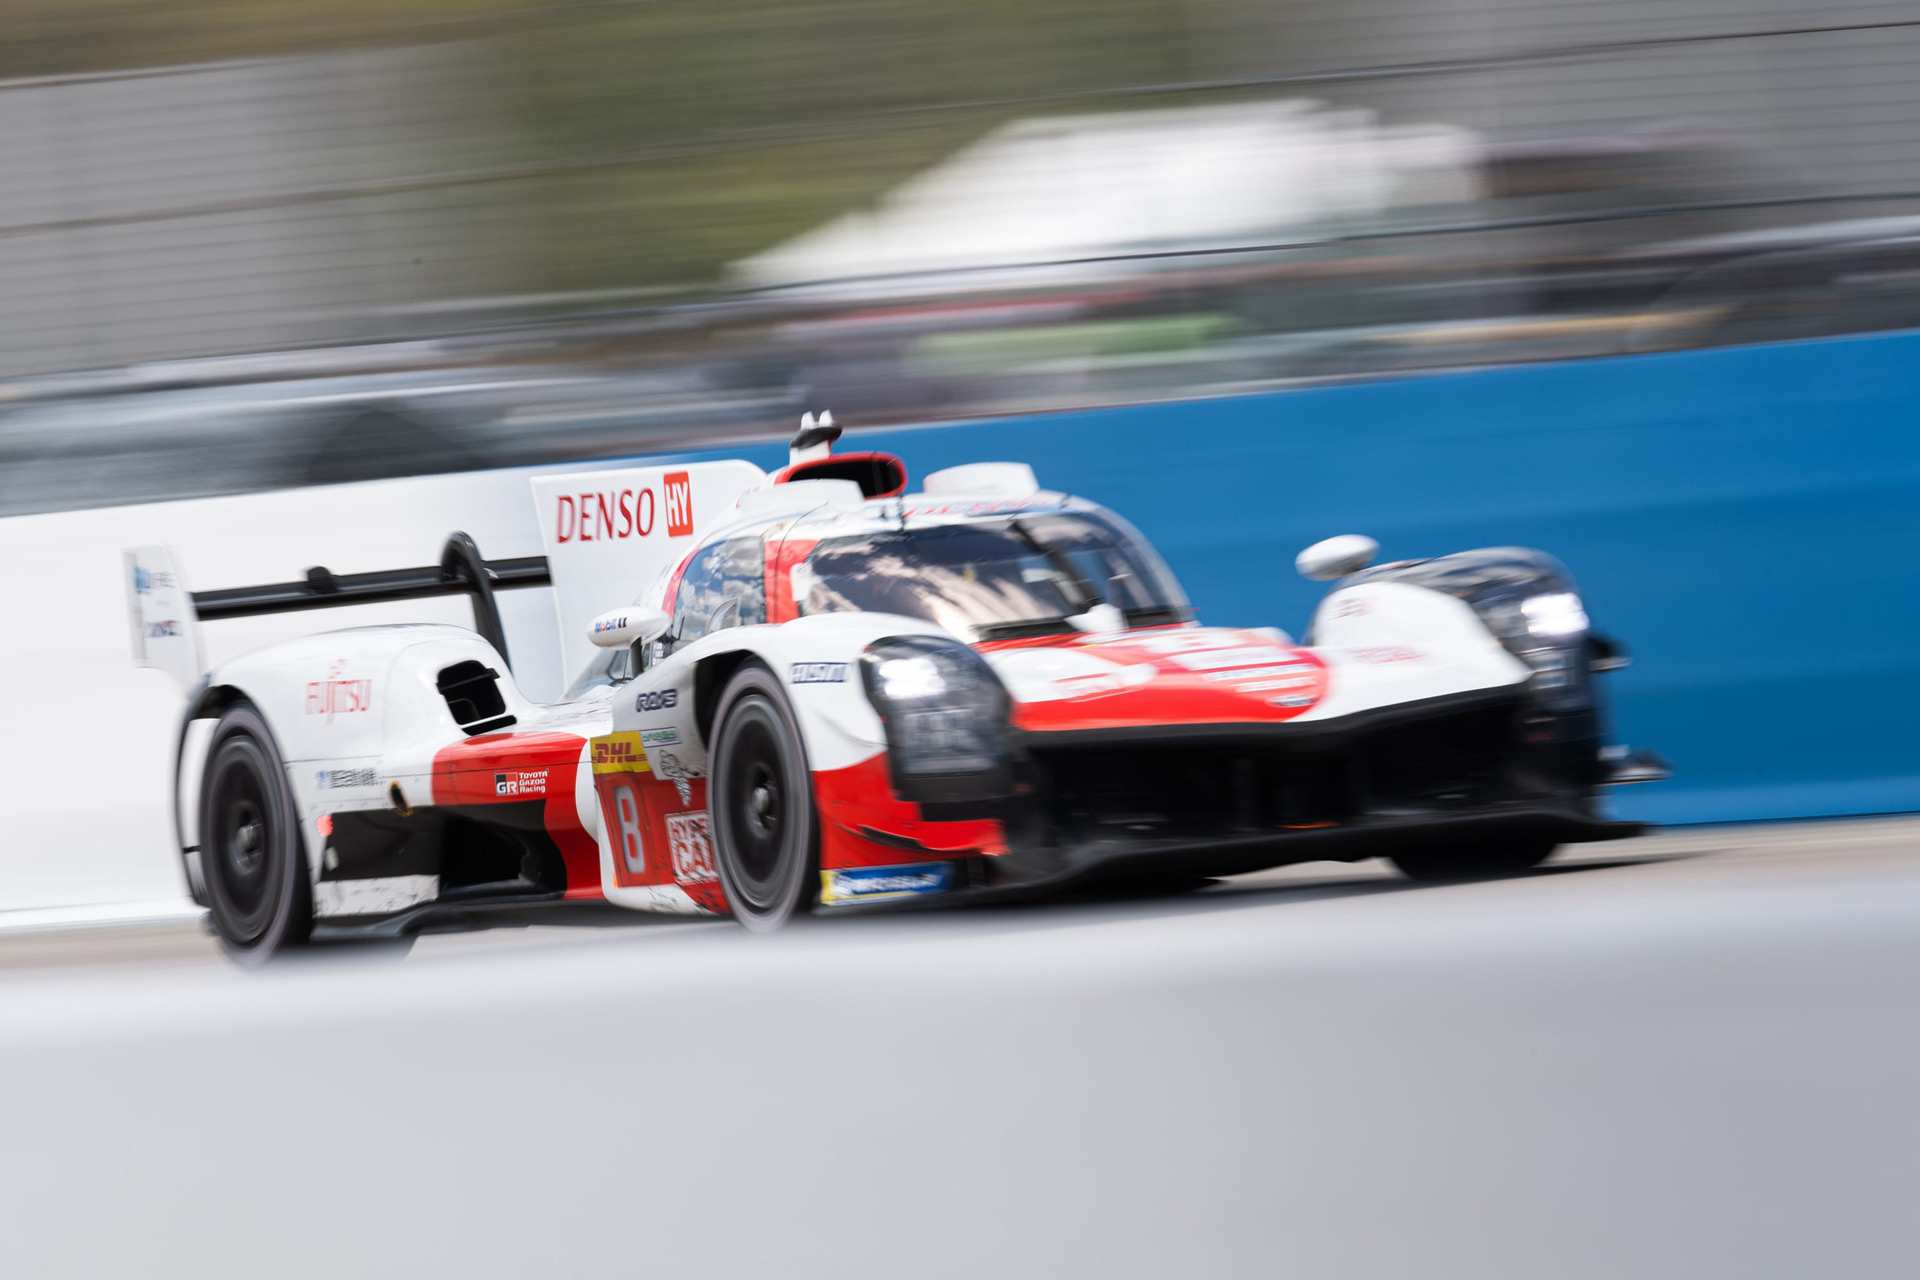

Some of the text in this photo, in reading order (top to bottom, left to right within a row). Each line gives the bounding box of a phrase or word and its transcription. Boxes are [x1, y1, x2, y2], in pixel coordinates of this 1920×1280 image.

[556, 481, 689, 543] DENSO HY
[305, 678, 372, 726] FUJITSU
[595, 741, 638, 764] DHL
[519, 770, 548, 780] TOYOTA
[519, 778, 546, 786] GAZOO
[496, 781, 518, 794] GR
[519, 785, 546, 794] Racing
[613, 785, 646, 874] 8
[669, 816, 711, 840] HYPE
